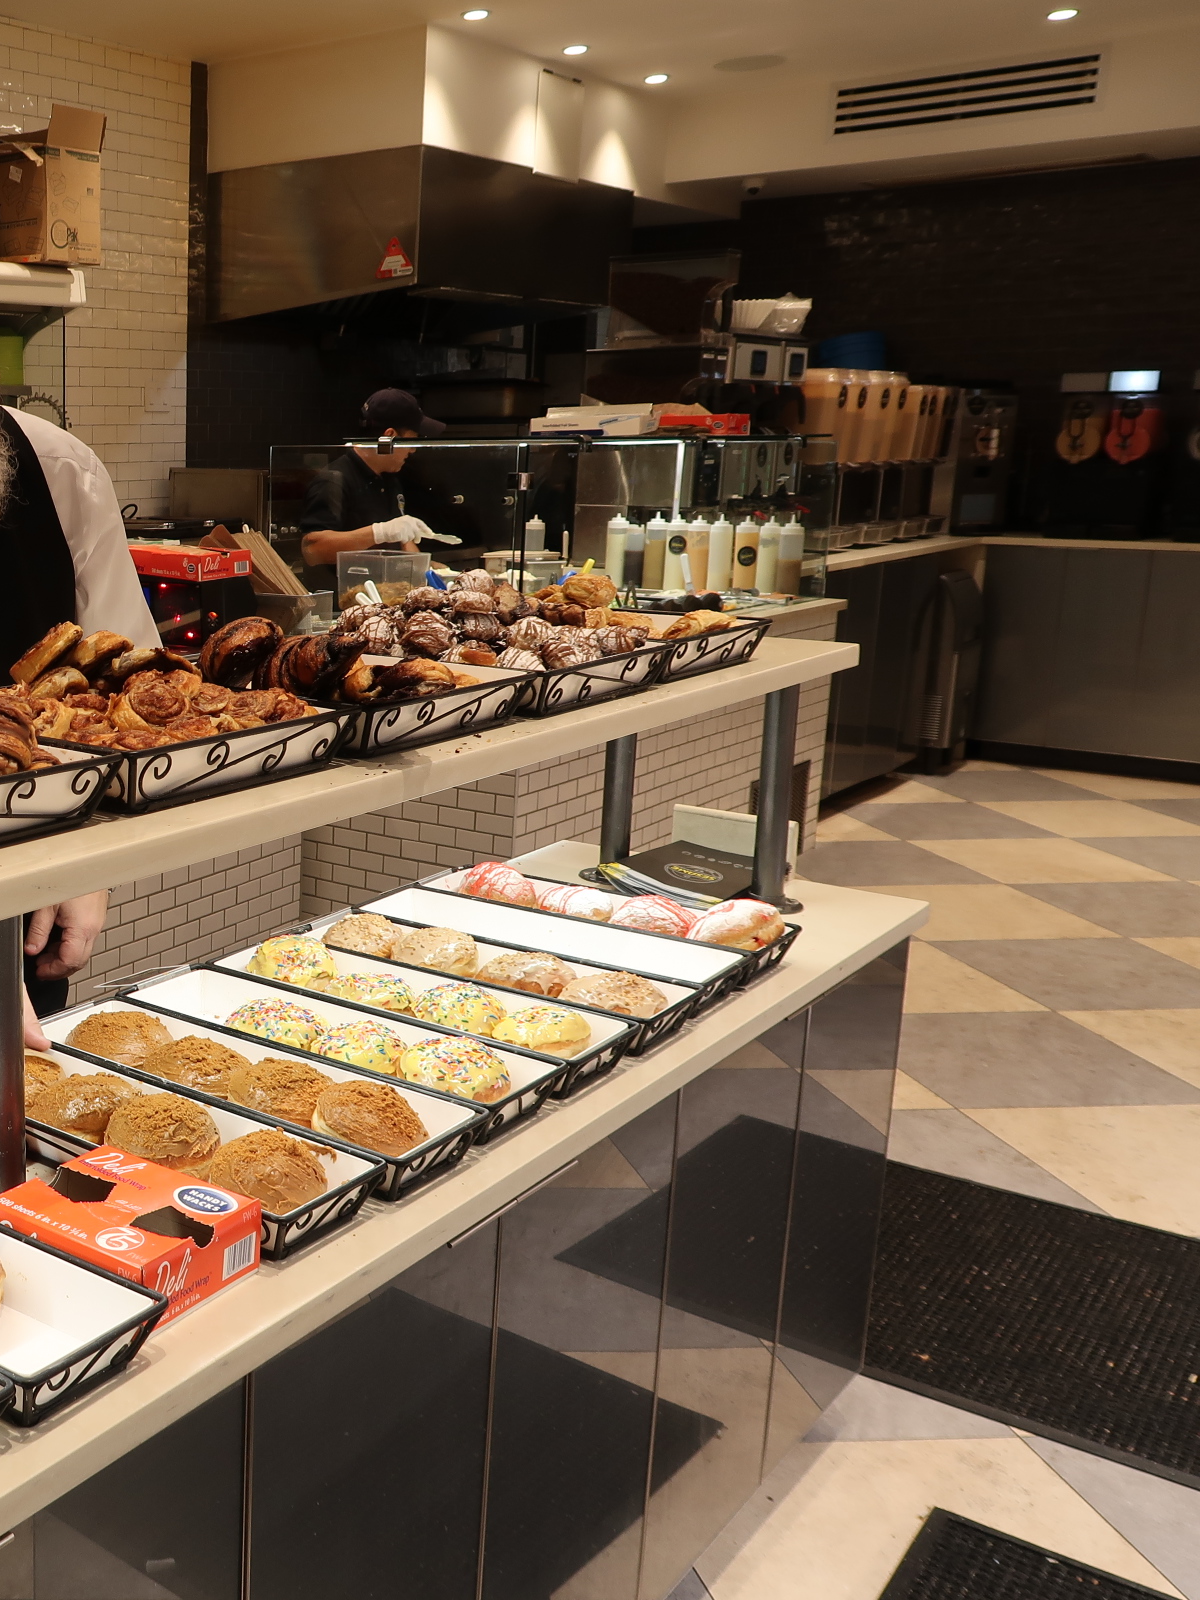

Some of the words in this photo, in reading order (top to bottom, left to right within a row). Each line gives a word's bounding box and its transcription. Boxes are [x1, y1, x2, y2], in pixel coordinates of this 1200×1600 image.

[204, 556, 220, 572] Deli
[84, 1153, 147, 1174] Deli
[112, 1174, 130, 1183] Food
[129, 1180, 147, 1190] Wrap
[182, 1194, 221, 1212] WACKS
[189, 1189, 228, 1207] HANDY
[12, 1205, 36, 1216] sheets
[242, 1208, 257, 1223] FW-6
[155, 1248, 192, 1296] Deli
[180, 1281, 194, 1298] Food
[196, 1276, 209, 1289] Wrap
